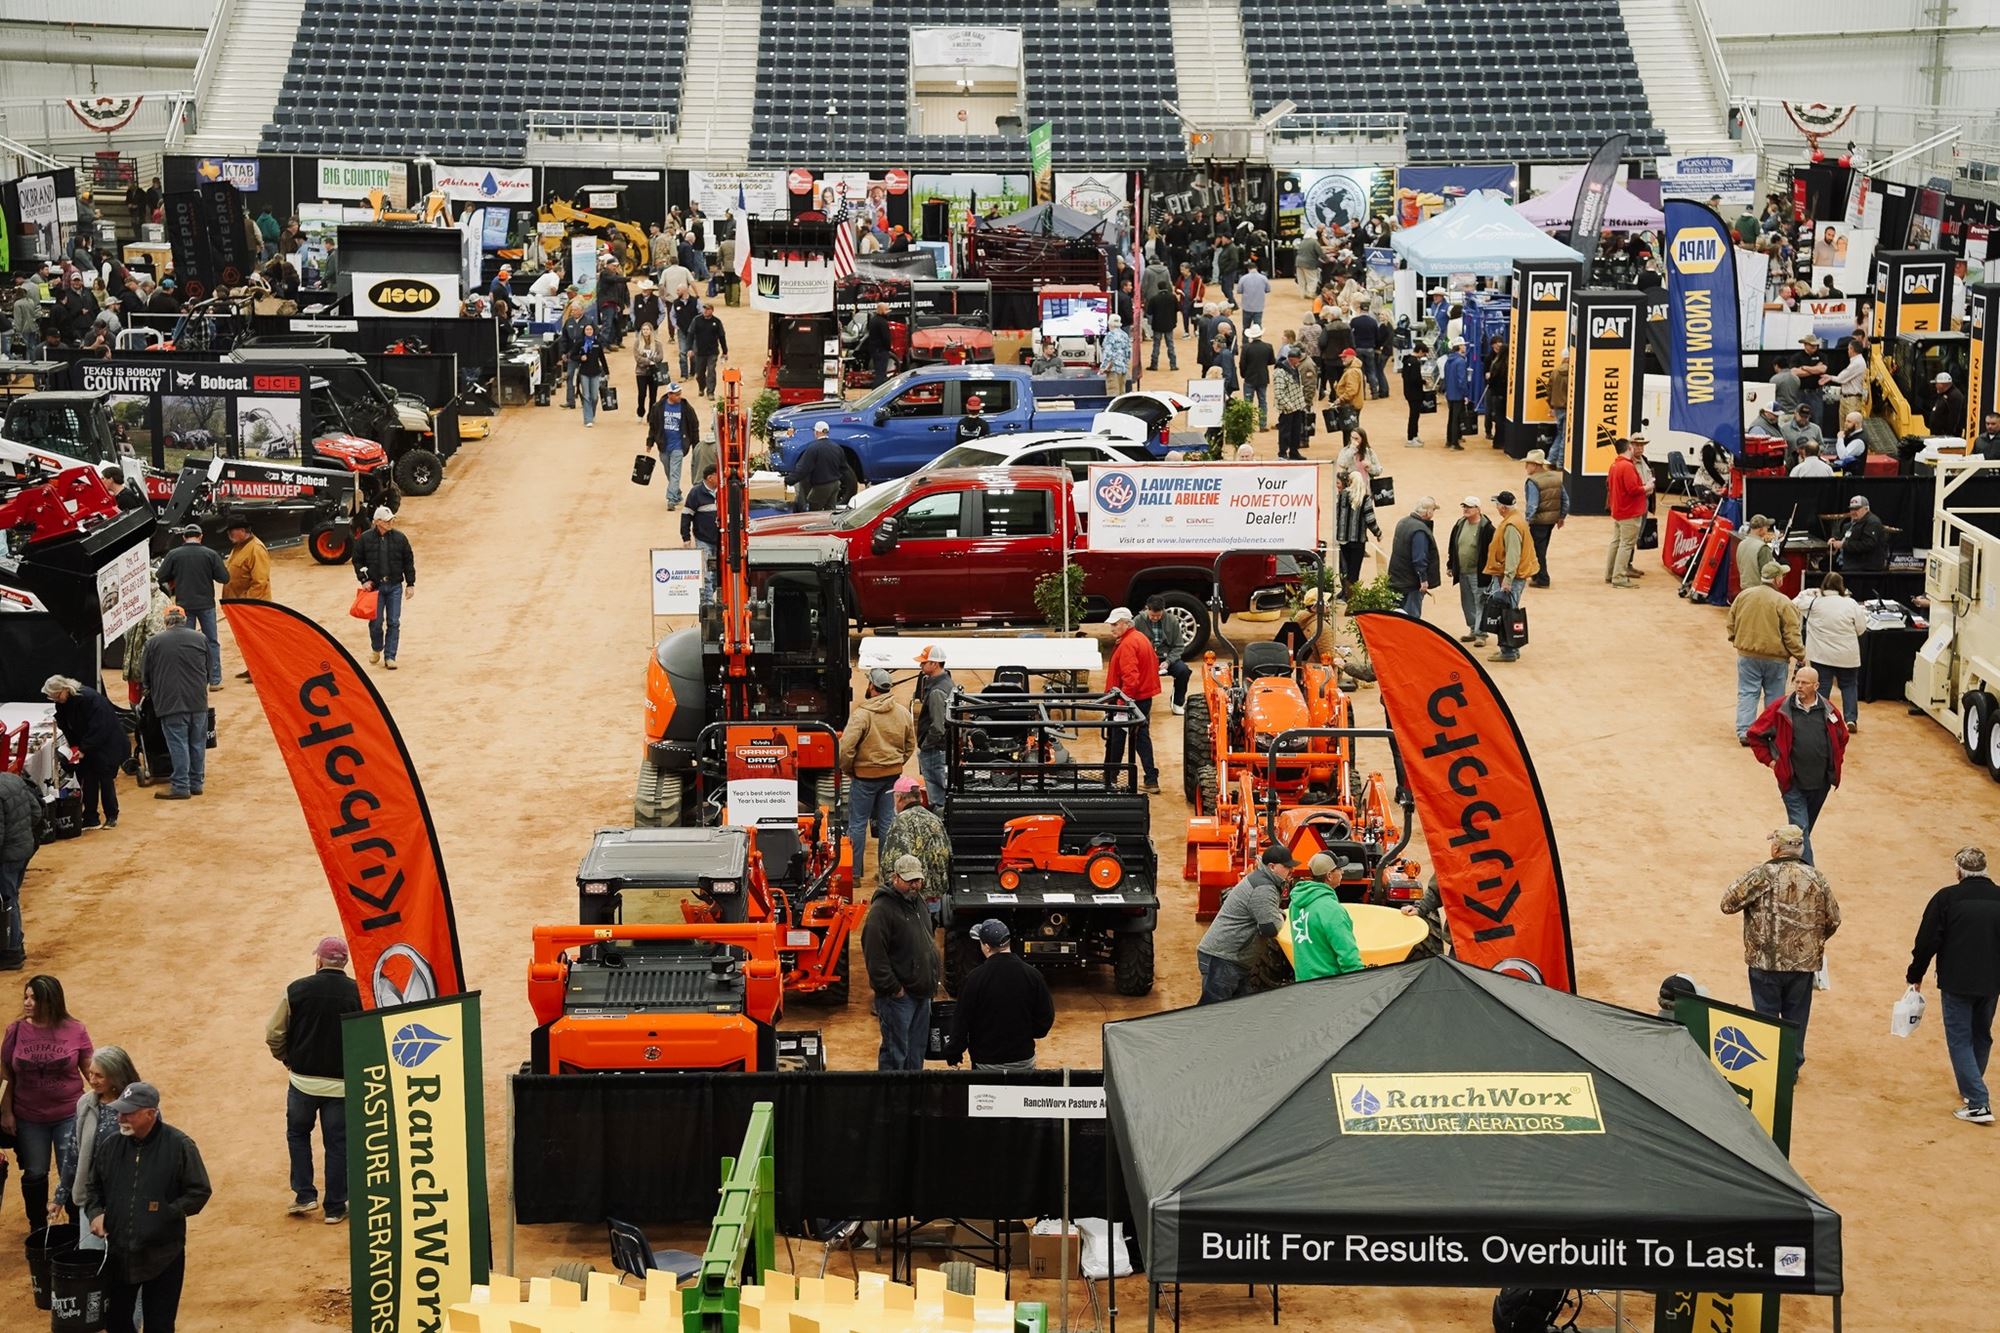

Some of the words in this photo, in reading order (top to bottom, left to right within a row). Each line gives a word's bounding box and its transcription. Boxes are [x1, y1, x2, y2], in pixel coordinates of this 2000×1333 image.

[224, 165, 254, 177] KTAB
[1680, 159, 1709, 167] JACKSON
[323, 167, 340, 184] BIG
[344, 168, 389, 186] COUNTRY
[438, 178, 480, 187] Abilene
[498, 180, 530, 188] Water
[20, 184, 55, 210] OKBRAND
[215, 192, 233, 262] SITEPRO
[177, 203, 197, 275] SITEPRO
[1532, 281, 1564, 301] CAT
[1904, 274, 1937, 295] CAT
[377, 287, 433, 304] ASCO
[1592, 317, 1627, 338] CAT
[83, 366, 114, 376] TEXAS
[115, 367, 124, 376] IS
[1535, 327, 1556, 400] WARREN
[84, 376, 161, 392] COUNTRY
[200, 375, 248, 391] Bobcat
[1596, 367, 1619, 449] WARREN
[296, 474, 328, 487] Bobcat
[1140, 478, 1223, 491] LAWRENCE
[1257, 477, 1287, 490] Your
[1138, 492, 1173, 505] HALL
[1175, 492, 1220, 505] ABILENE
[1230, 493, 1314, 508] HOMETOWN
[1245, 511, 1297, 525] Dealer!!
[1119, 536, 1134, 544] Visit
[1157, 536, 1285, 545] www.lawrencehallofabilenetx.com
[298, 670, 405, 931] Kubota
[1422, 682, 1522, 943] Kubota
[1023, 1097, 1067, 1108] RanchWorx
[1068, 1098, 1098, 1108] Pasture
[1386, 1087, 1573, 1109] RanchWorx
[363, 1064, 390, 1187] PASTURE
[1377, 1117, 1461, 1131] PASTURE
[1467, 1117, 1565, 1131] AERATORS
[406, 1074, 450, 1333] RanchWorx
[1202, 1232, 1271, 1260] Built
[1282, 1233, 1335, 1261] For
[1345, 1234, 1469, 1262] Results.
[1481, 1235, 1627, 1266] Overbuilt
[1636, 1238, 1675, 1267] To
[1686, 1239, 1764, 1269] Last.
[367, 1195, 394, 1333] AERATORS
